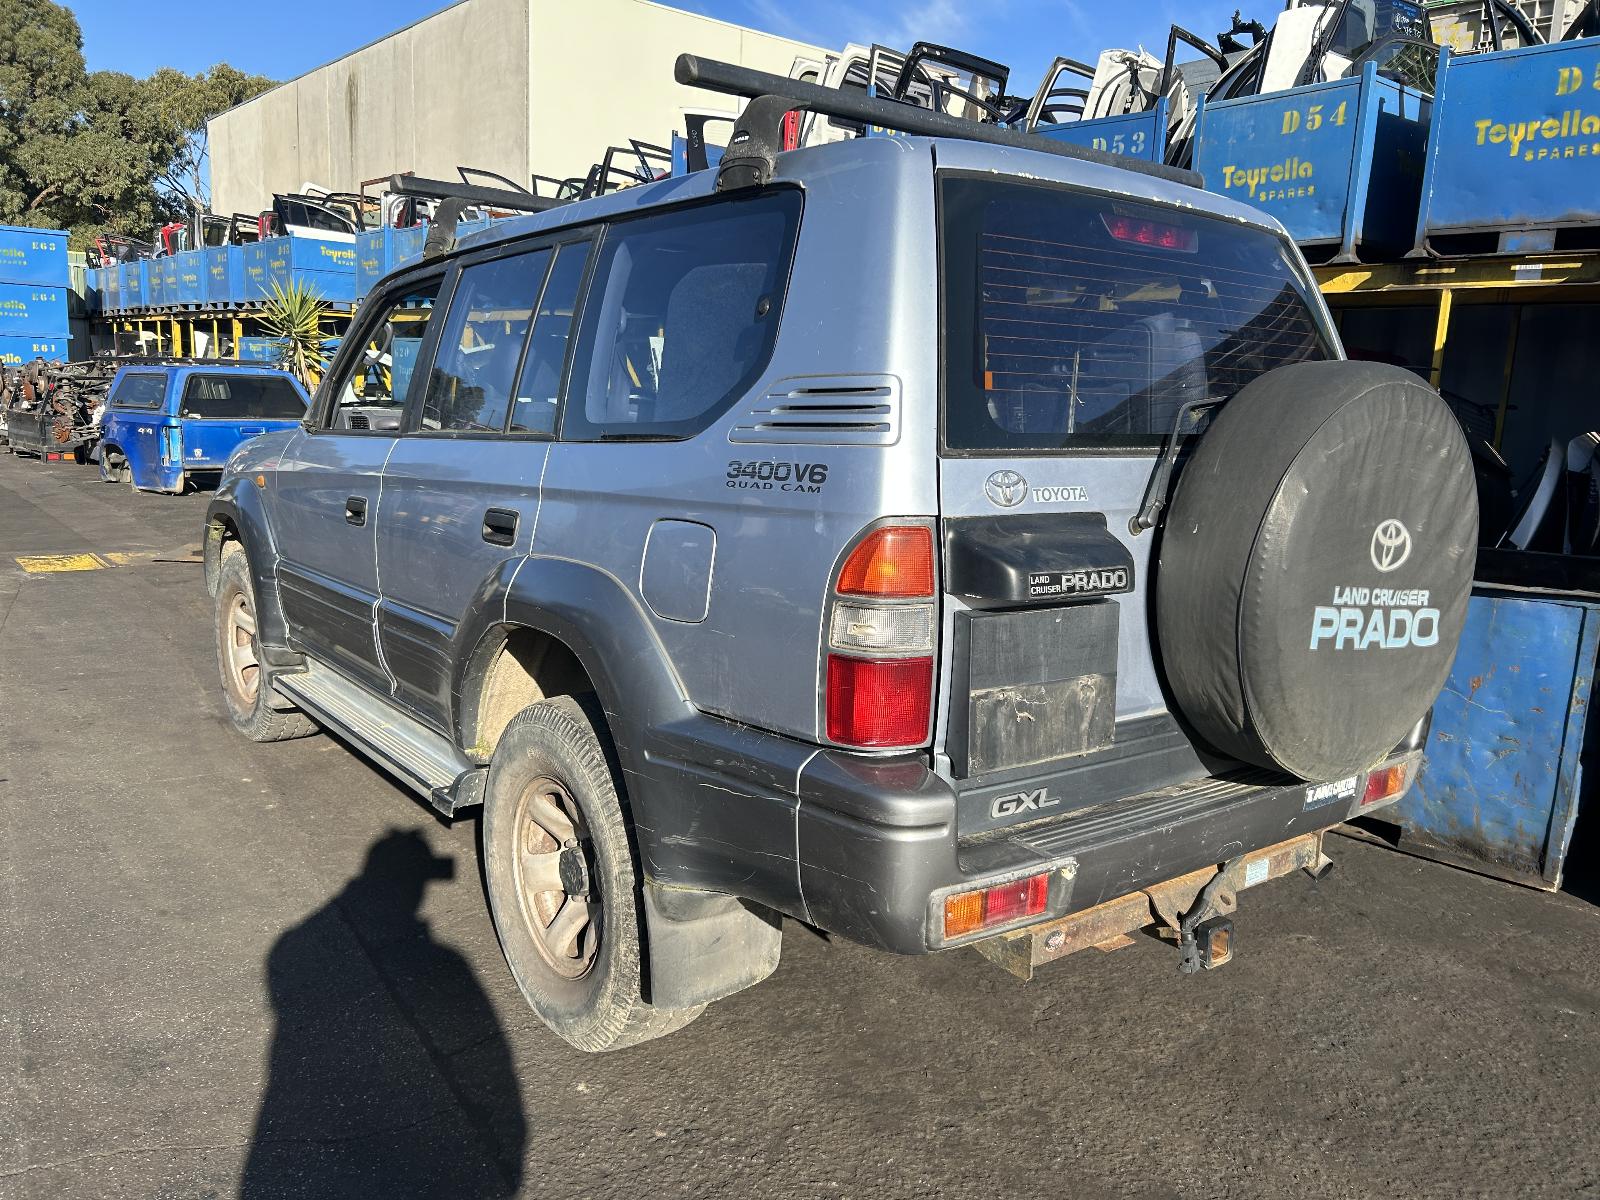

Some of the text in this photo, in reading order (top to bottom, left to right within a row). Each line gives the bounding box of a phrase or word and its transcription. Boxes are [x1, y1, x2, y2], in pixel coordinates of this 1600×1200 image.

[1280, 100, 1347, 135] D54
[1524, 143, 1600, 161] SPARES
[1259, 185, 1315, 202] SPARES
[726, 480, 821, 494] QUAD CAM
[1032, 487, 1088, 502] TOYOTA
[1030, 575, 1050, 585] LAND
[1061, 571, 1127, 592] PRADO
[1030, 585, 1062, 595] CRUISER
[1333, 586, 1430, 606] LAND CRUISER
[1309, 606, 1440, 650] PRADO
[991, 787, 1060, 818] GXL
